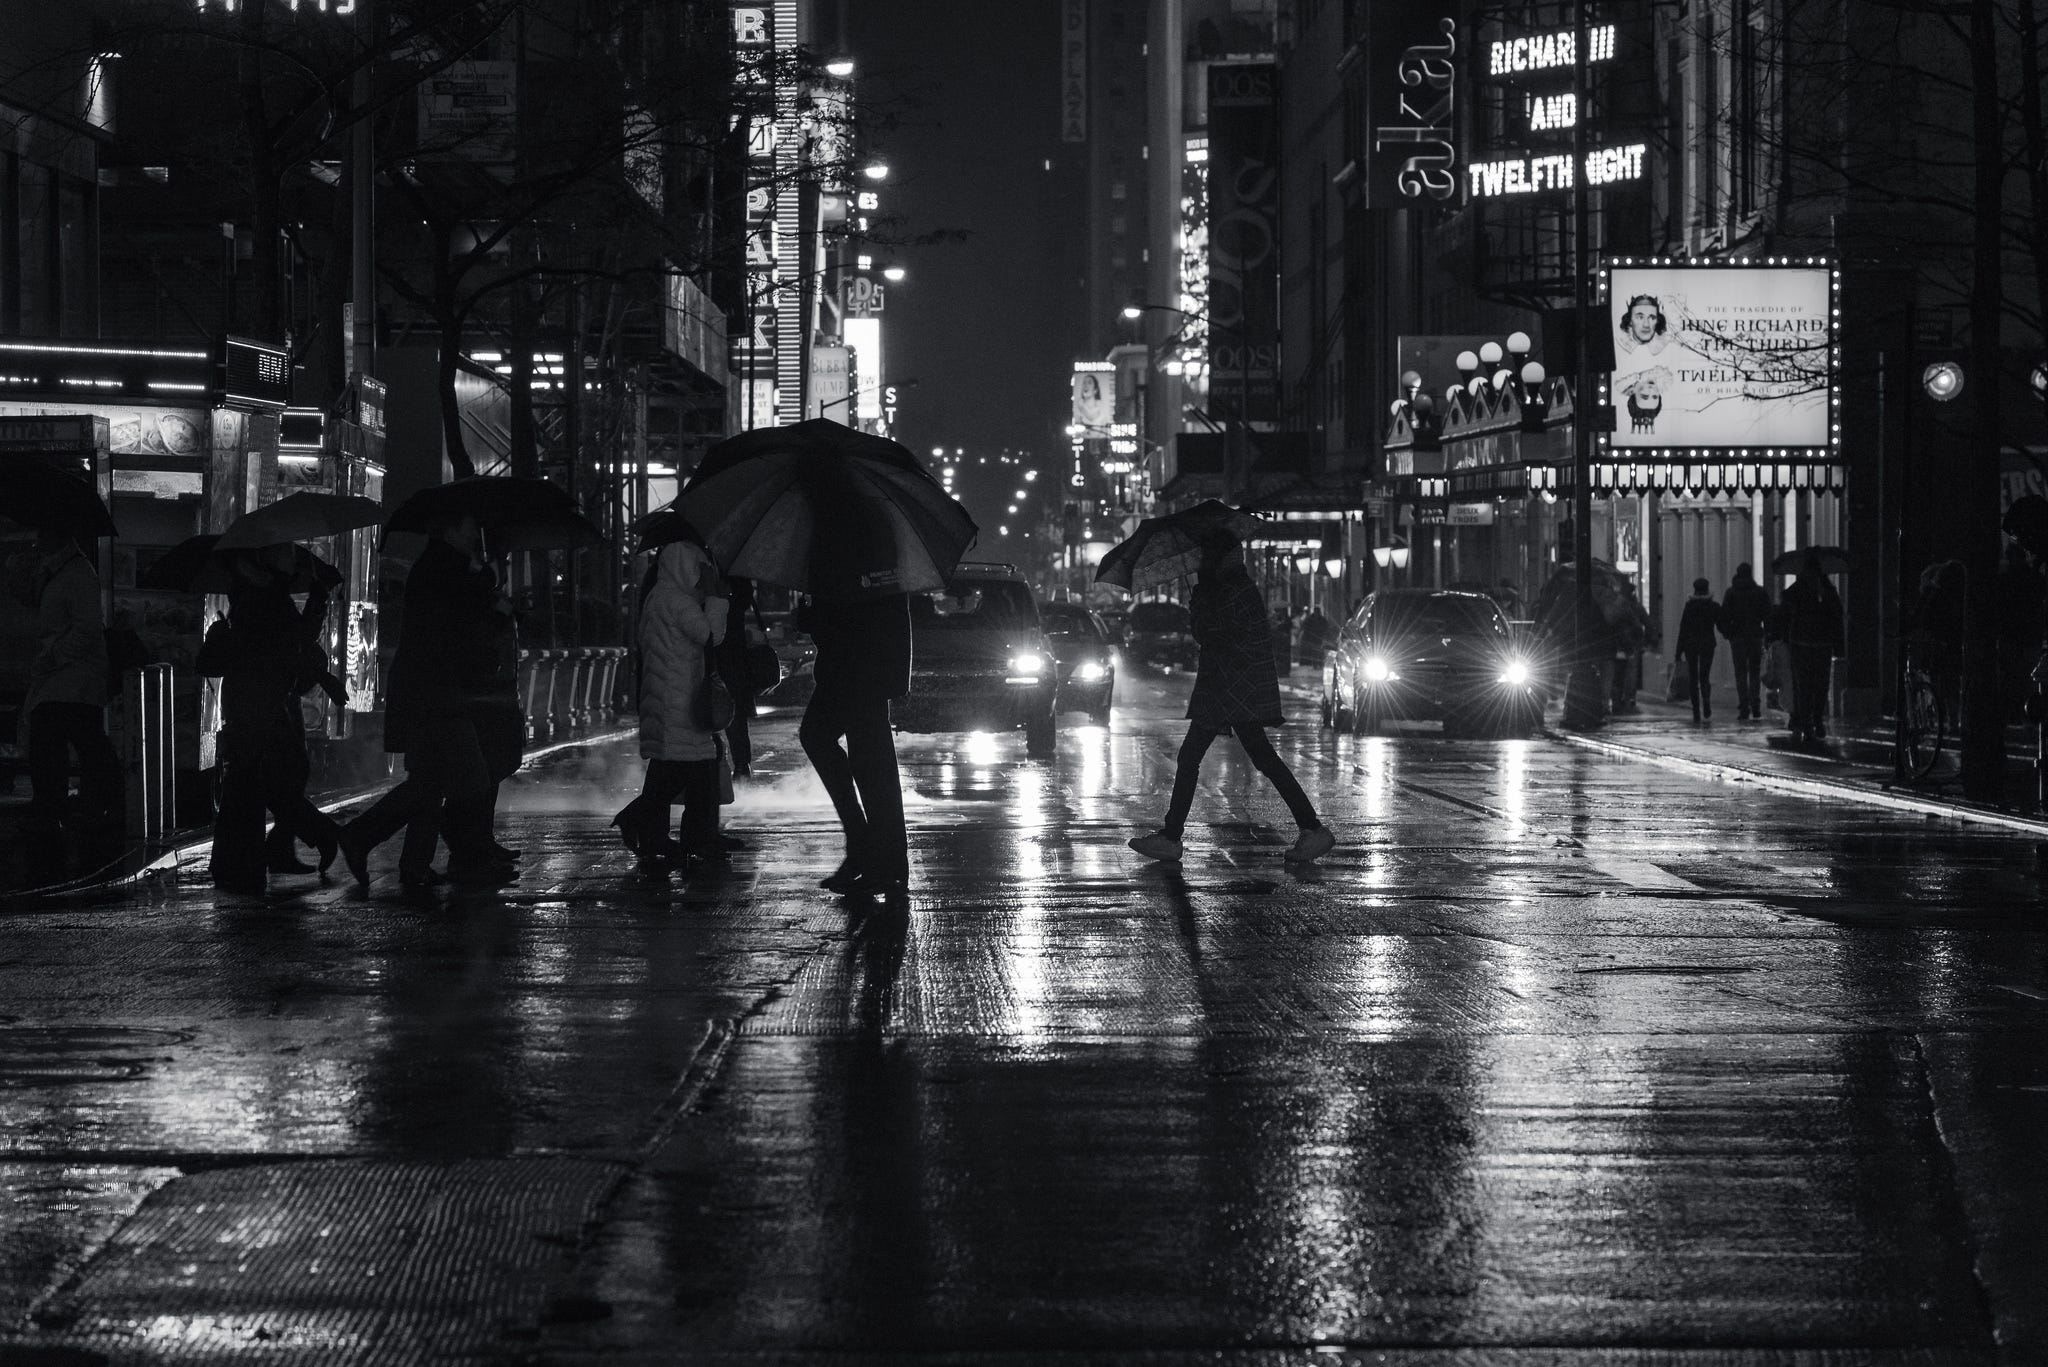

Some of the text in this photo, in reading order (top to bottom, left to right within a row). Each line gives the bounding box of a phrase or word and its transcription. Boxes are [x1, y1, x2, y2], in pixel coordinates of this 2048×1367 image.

[1589, 25, 1615, 62] III
[1531, 93, 1576, 130] AND
[1469, 154, 1573, 196] TWELFTH
[1735, 318, 1823, 332] RICHARD
[1747, 337, 1809, 351] THIRD
